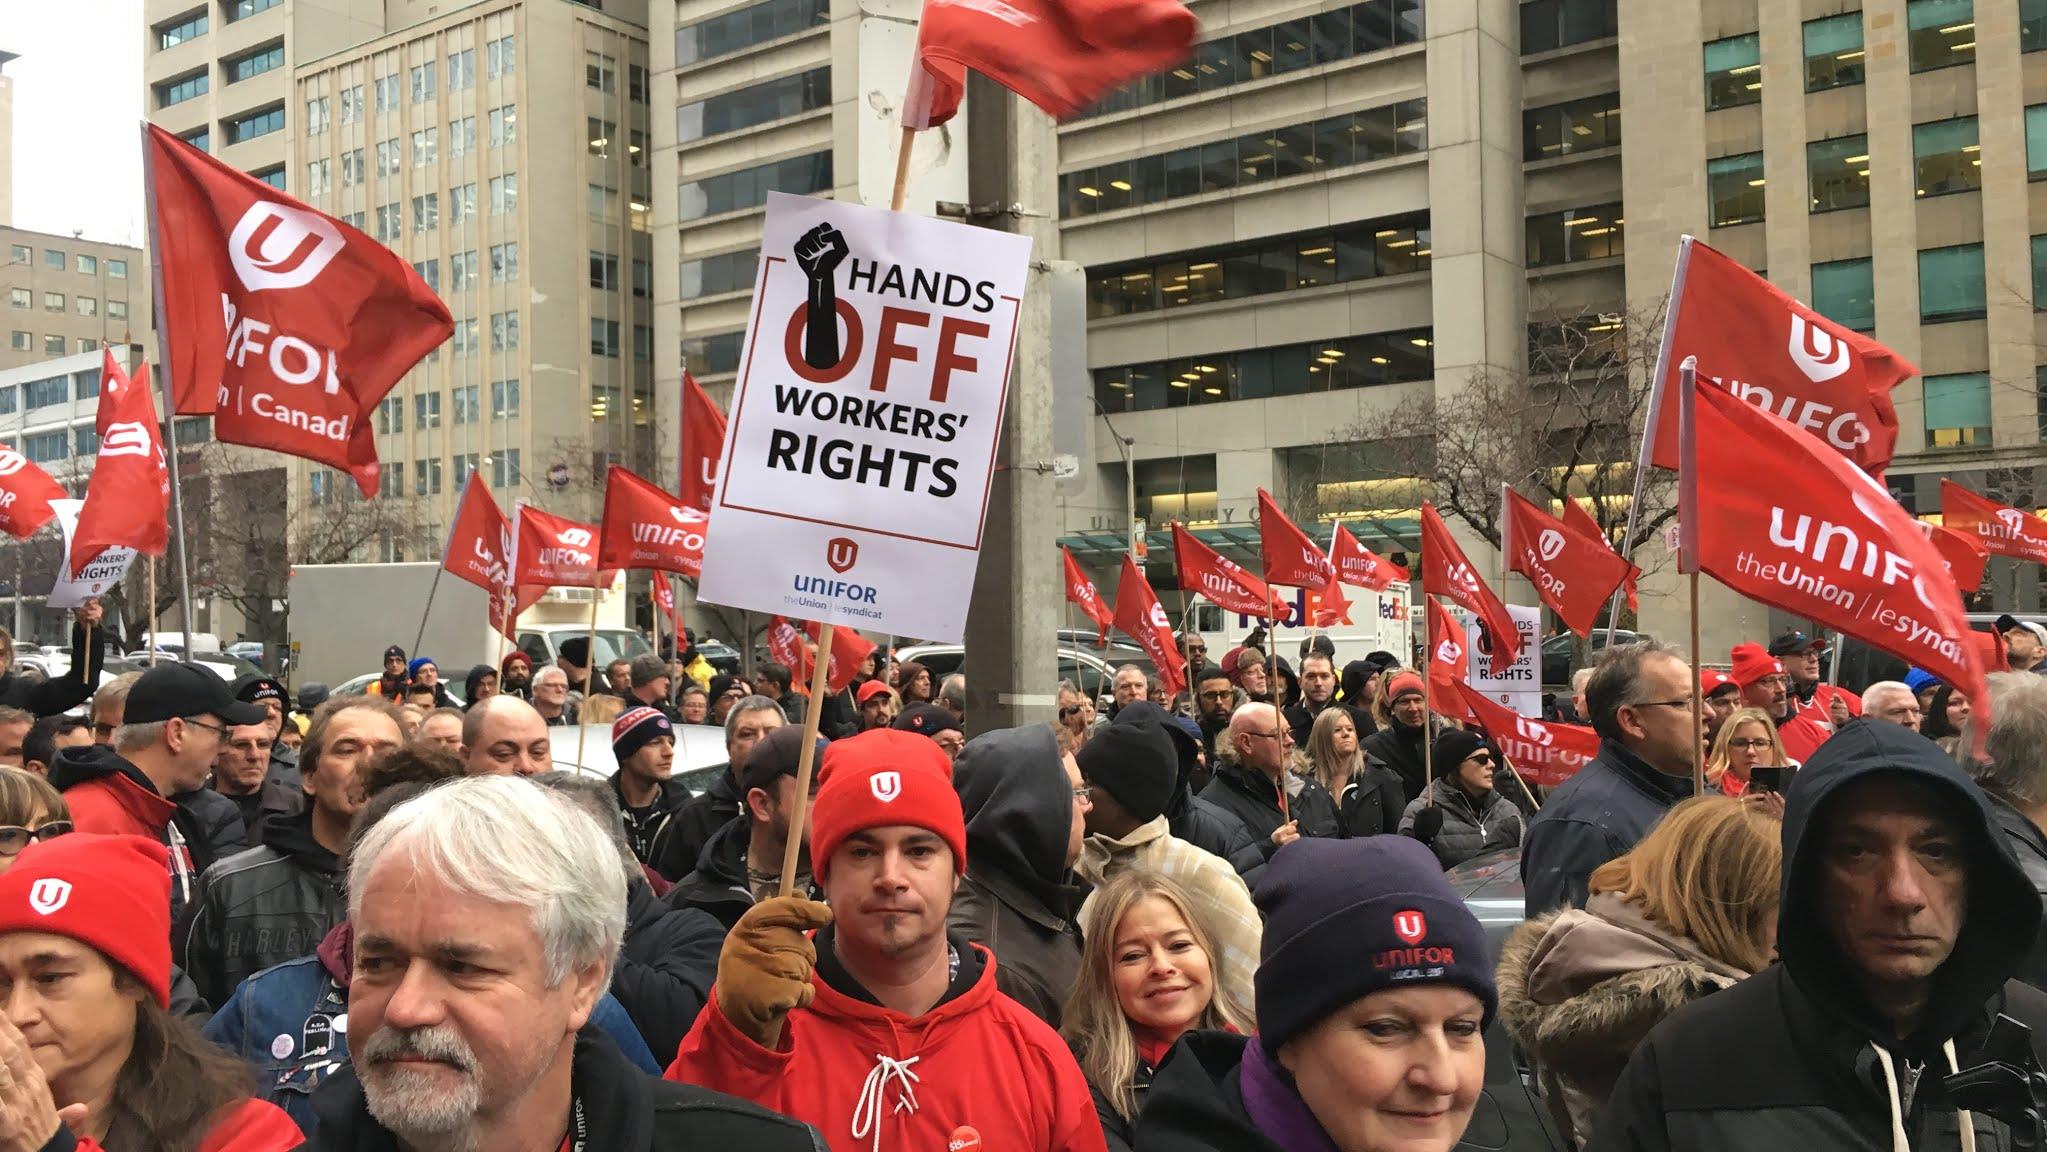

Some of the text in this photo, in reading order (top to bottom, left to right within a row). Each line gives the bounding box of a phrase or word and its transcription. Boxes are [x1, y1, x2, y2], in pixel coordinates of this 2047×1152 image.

[848, 258, 995, 313] HANDS
[784, 296, 991, 403] OFF
[251, 393, 353, 441] Canad
[775, 384, 969, 442] WORKERS'
[766, 428, 959, 498] RIGHTS
[632, 522, 704, 551] UNIFO
[1379, 595, 1409, 620] FedEx
[1736, 551, 1855, 610] theUnion
